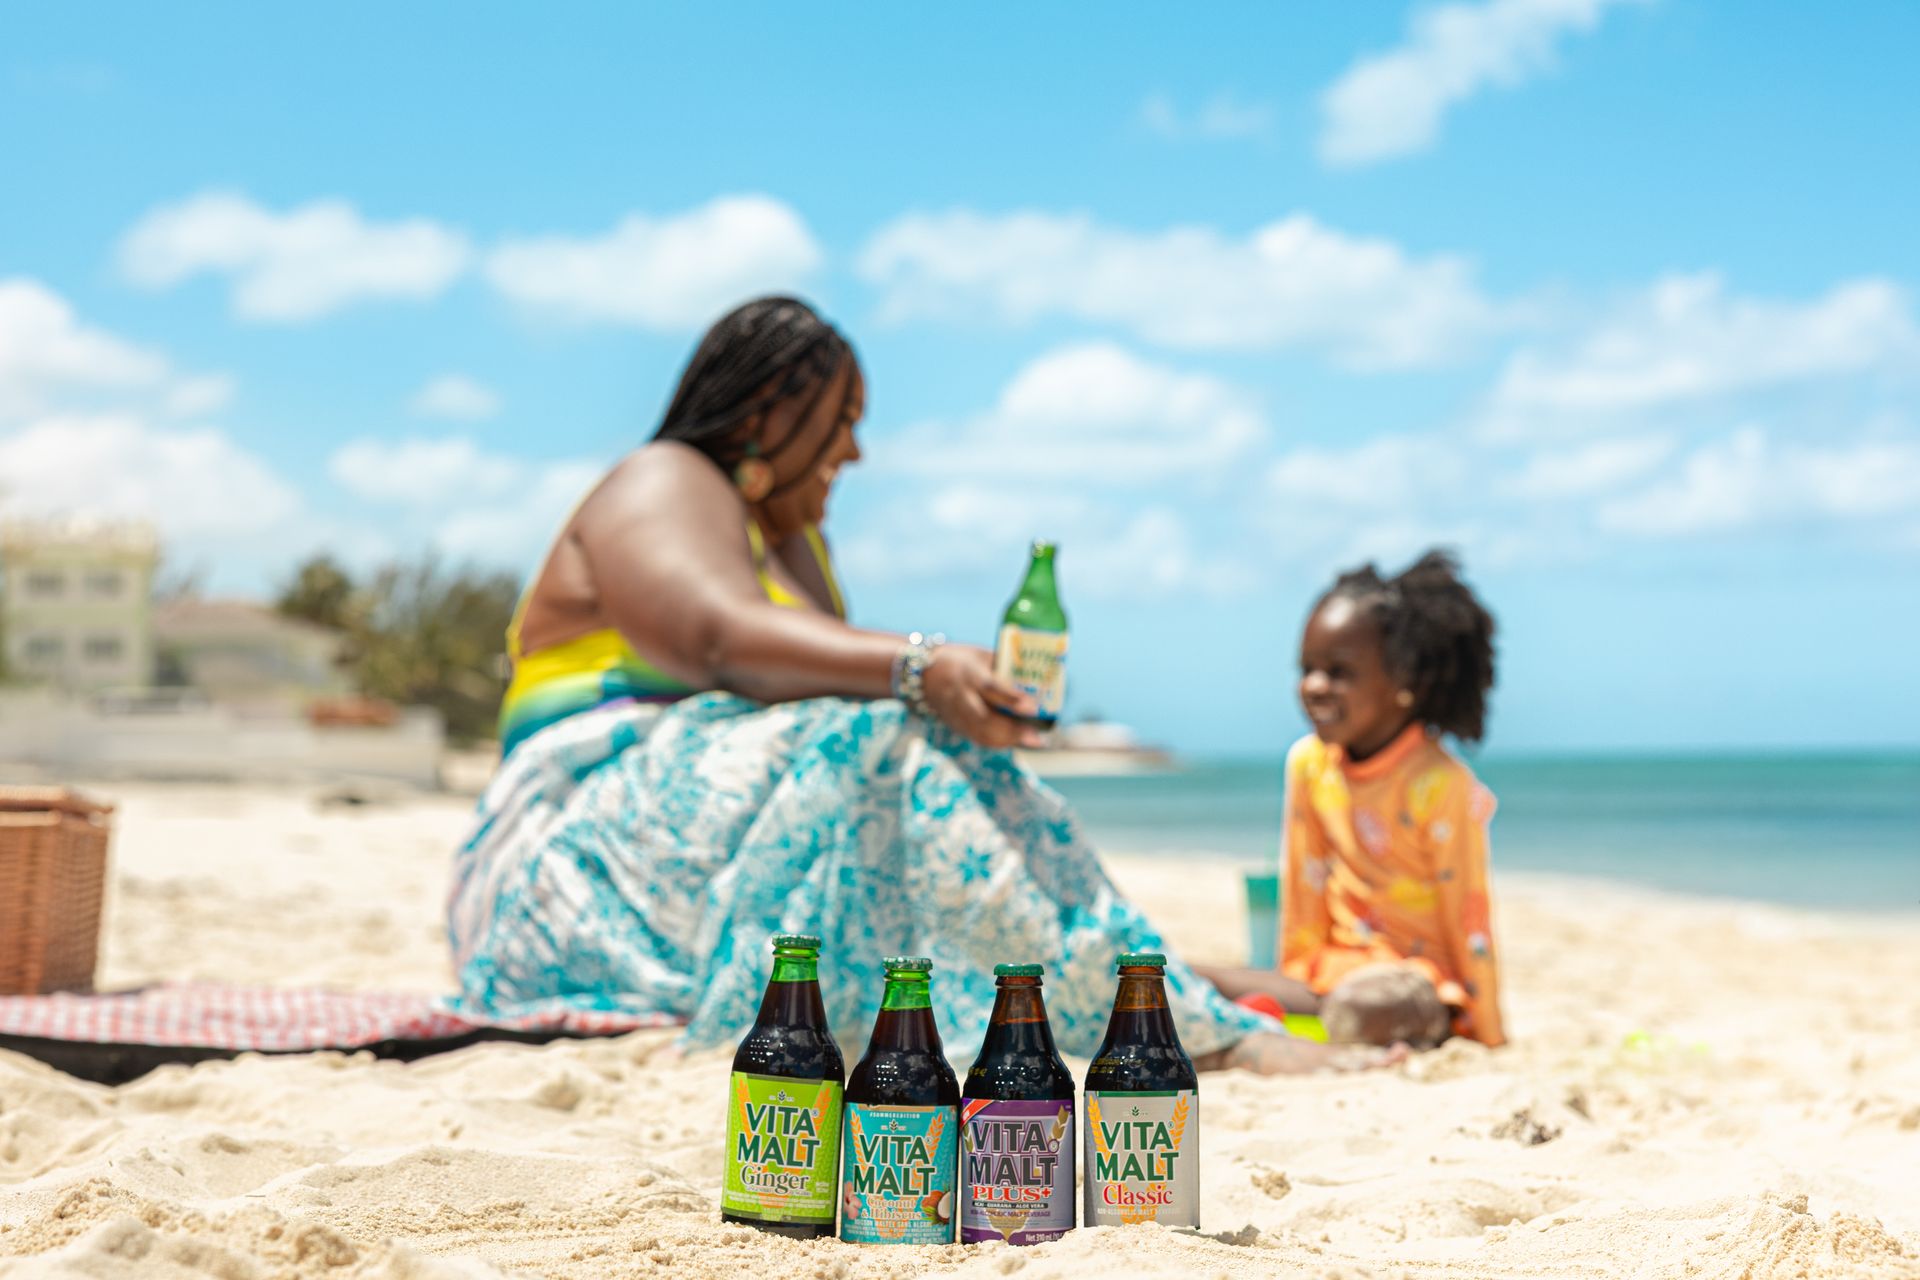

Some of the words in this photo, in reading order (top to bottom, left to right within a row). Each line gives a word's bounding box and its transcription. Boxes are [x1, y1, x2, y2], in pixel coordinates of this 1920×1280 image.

[745, 1102, 816, 1138] VITA
[859, 1134, 931, 1165] VITA
[971, 1120, 1048, 1153] VITA
[1100, 1121, 1174, 1150] VITA
[737, 1132, 820, 1169] MALT
[741, 1165, 809, 1194] Ginger
[854, 1164, 936, 1197] MALT
[968, 1153, 1058, 1187] MALT
[1096, 1152, 1180, 1181] MALT
[867, 1197, 916, 1208] Coconut
[973, 1186, 1052, 1202] PLUS+
[1103, 1184, 1174, 1205] Classic
[870, 1208, 922, 1219] Hibiscus
